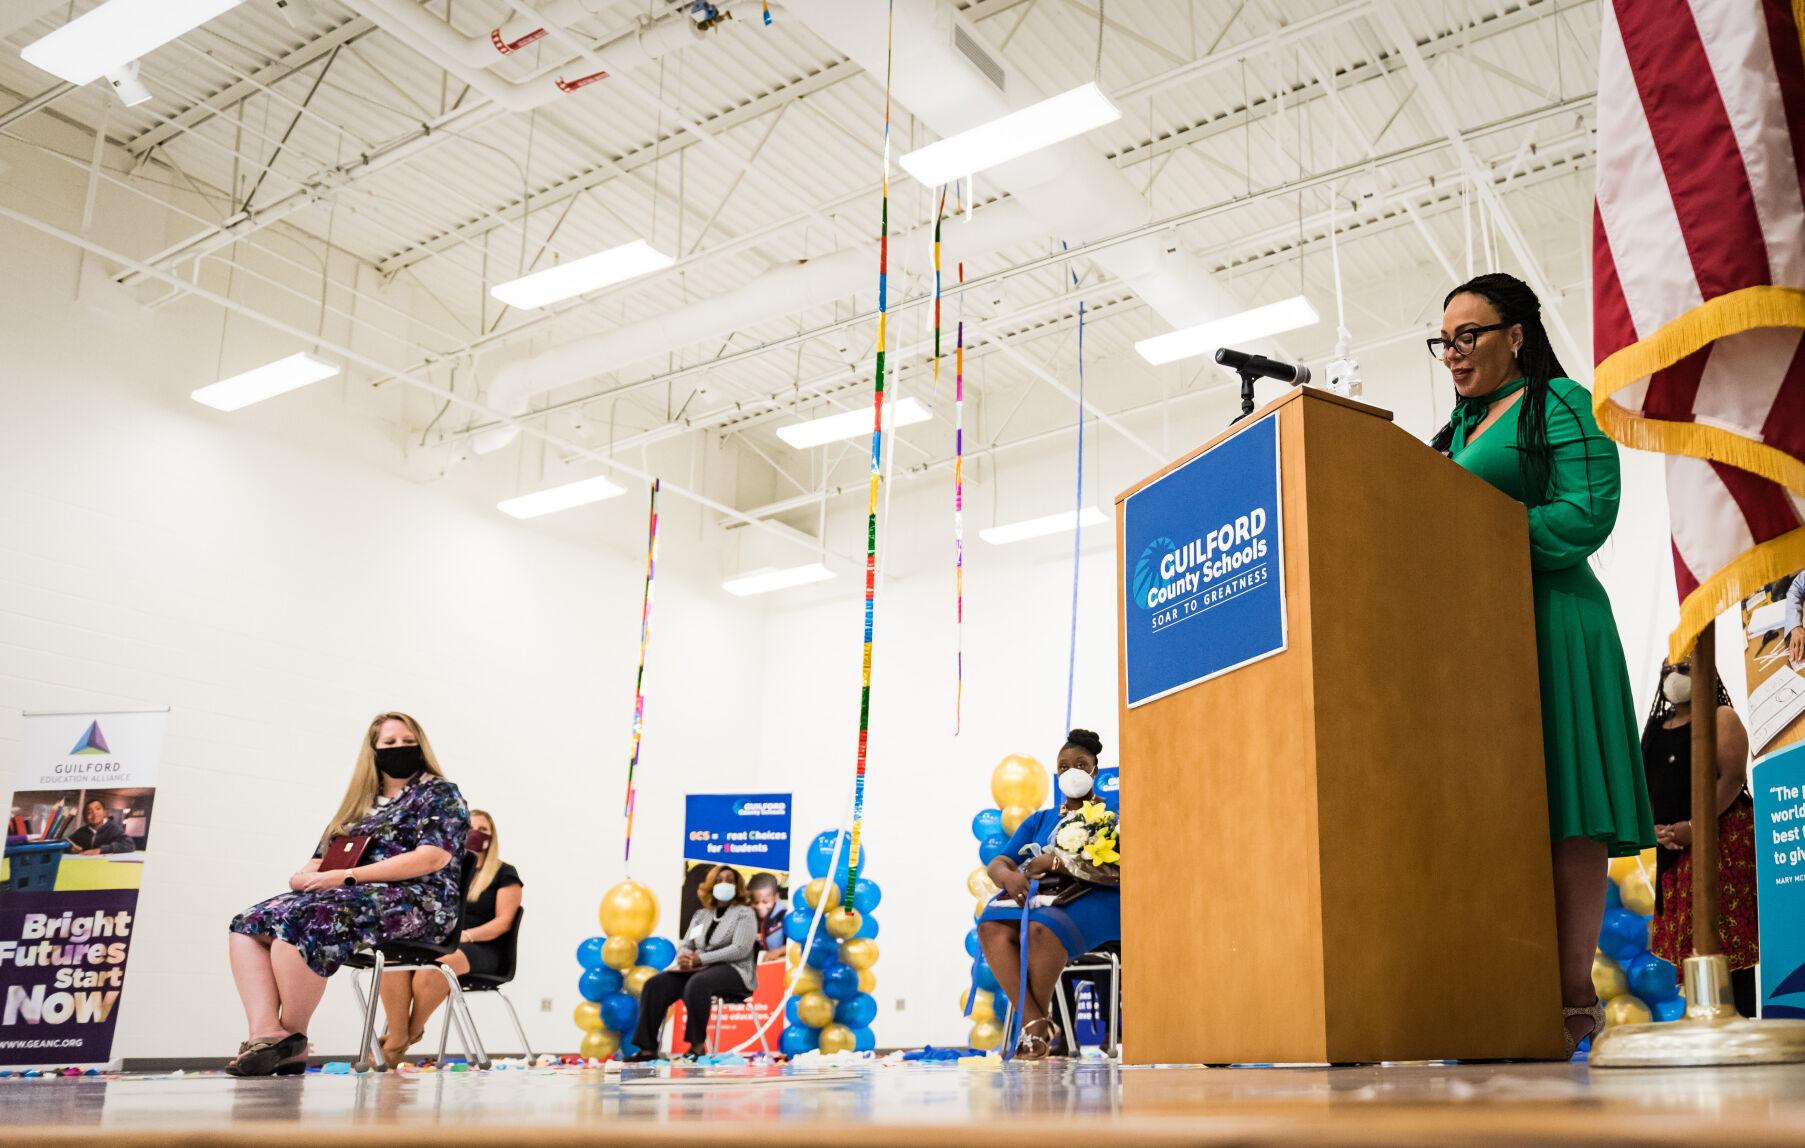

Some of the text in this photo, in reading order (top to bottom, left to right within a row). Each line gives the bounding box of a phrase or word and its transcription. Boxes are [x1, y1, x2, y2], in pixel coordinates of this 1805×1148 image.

[1160, 507, 1266, 580] GUILFORD
[1147, 537, 1267, 608] County Schools
[1152, 567, 1268, 629] SOAR TO GREATNESS
[55, 762, 121, 774] GUILFORD
[39, 773, 131, 784] EDUCATION ALLIANCE
[748, 829, 788, 841] Choices
[1772, 826, 1800, 845] best
[707, 843, 769, 853] for Students
[1774, 851, 1787, 865] to
[1775, 876, 1793, 885] MARY
[21, 910, 132, 943] Bright
[0, 940, 127, 967] Futures
[54, 966, 123, 989] Start
